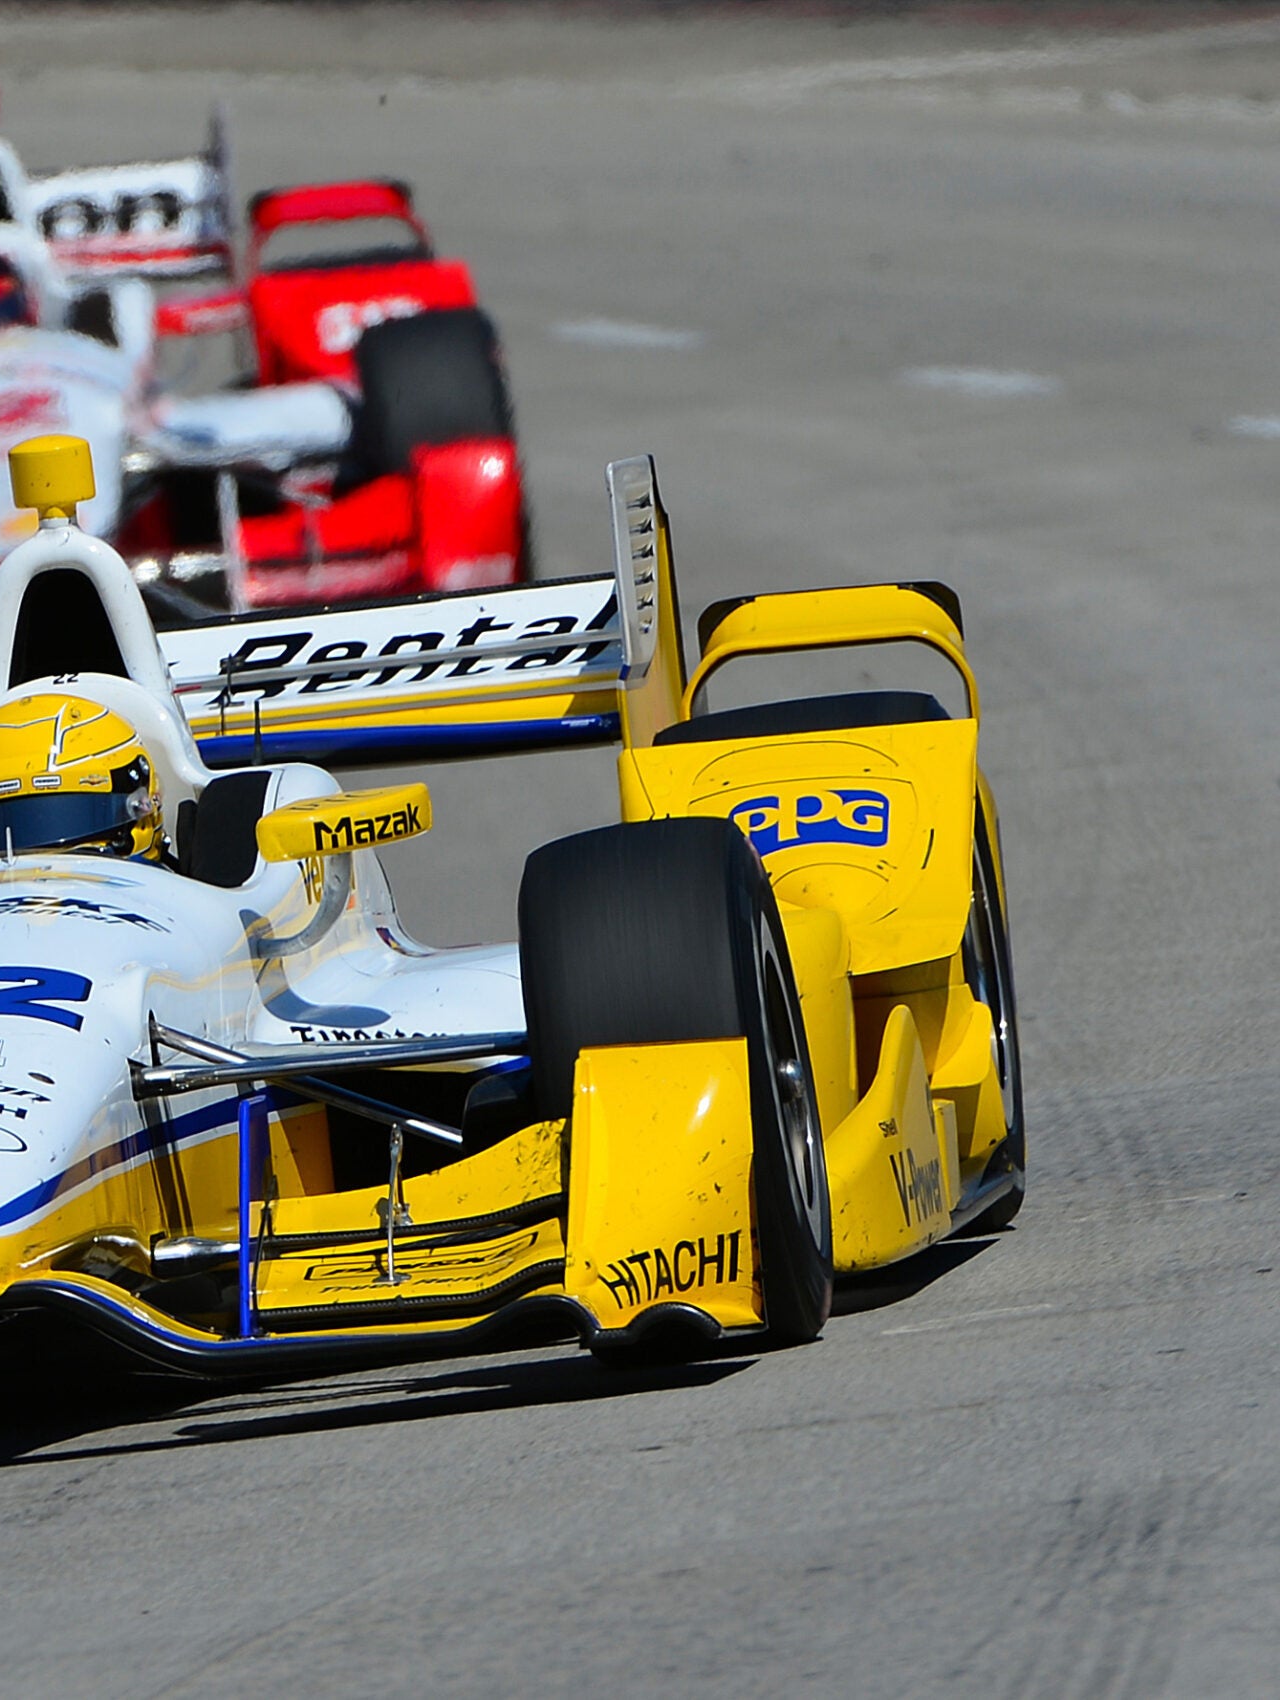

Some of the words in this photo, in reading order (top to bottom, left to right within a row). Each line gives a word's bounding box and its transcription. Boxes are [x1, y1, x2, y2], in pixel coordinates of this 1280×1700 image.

[205, 593, 618, 706] Rental
[314, 803, 422, 851] Mazak
[733, 789, 884, 842] PPG
[598, 1229, 742, 1309] HITACHI
